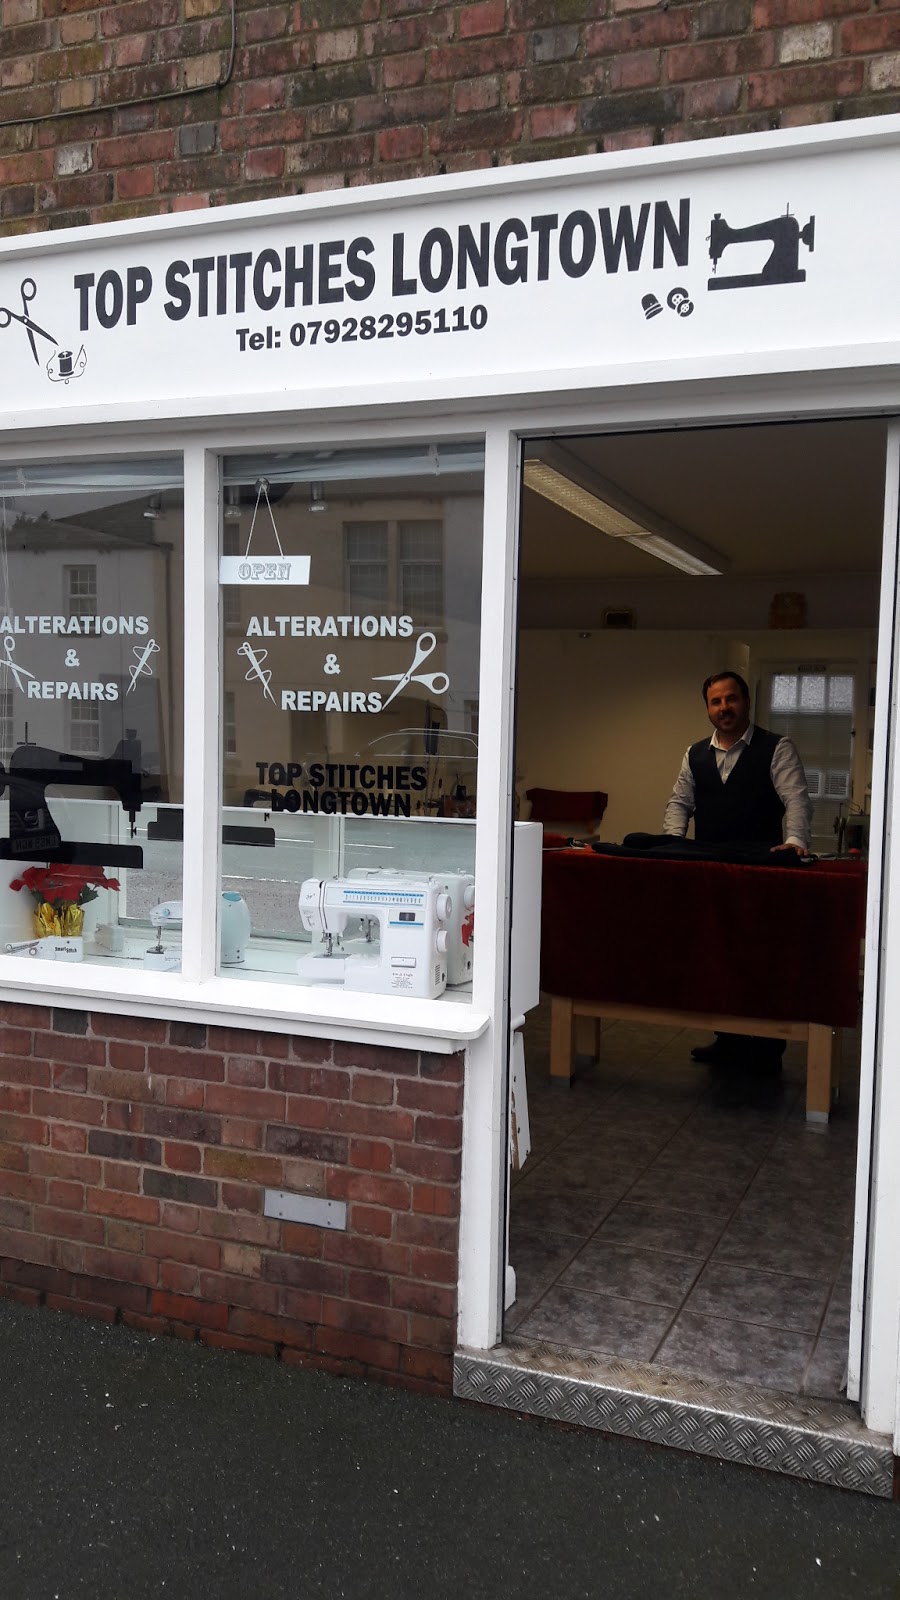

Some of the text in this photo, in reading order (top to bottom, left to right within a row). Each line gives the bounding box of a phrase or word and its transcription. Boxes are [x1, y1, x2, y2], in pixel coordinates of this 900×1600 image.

[73, 197, 691, 332] TOP STITCHES LONGTOWN
[235, 304, 488, 352] Tel: 07928295110
[238, 563, 292, 580] OPEN
[0, 615, 149, 635] ALTERATIONS
[246, 615, 414, 637] ALTERATIONS
[64, 648, 80, 667] &
[323, 653, 341, 675] &
[27, 680, 119, 701] REPAIRS
[281, 690, 383, 713] REPAIRS
[255, 761, 428, 790] TOP STITCHES
[271, 788, 411, 818] LONGTOWN
